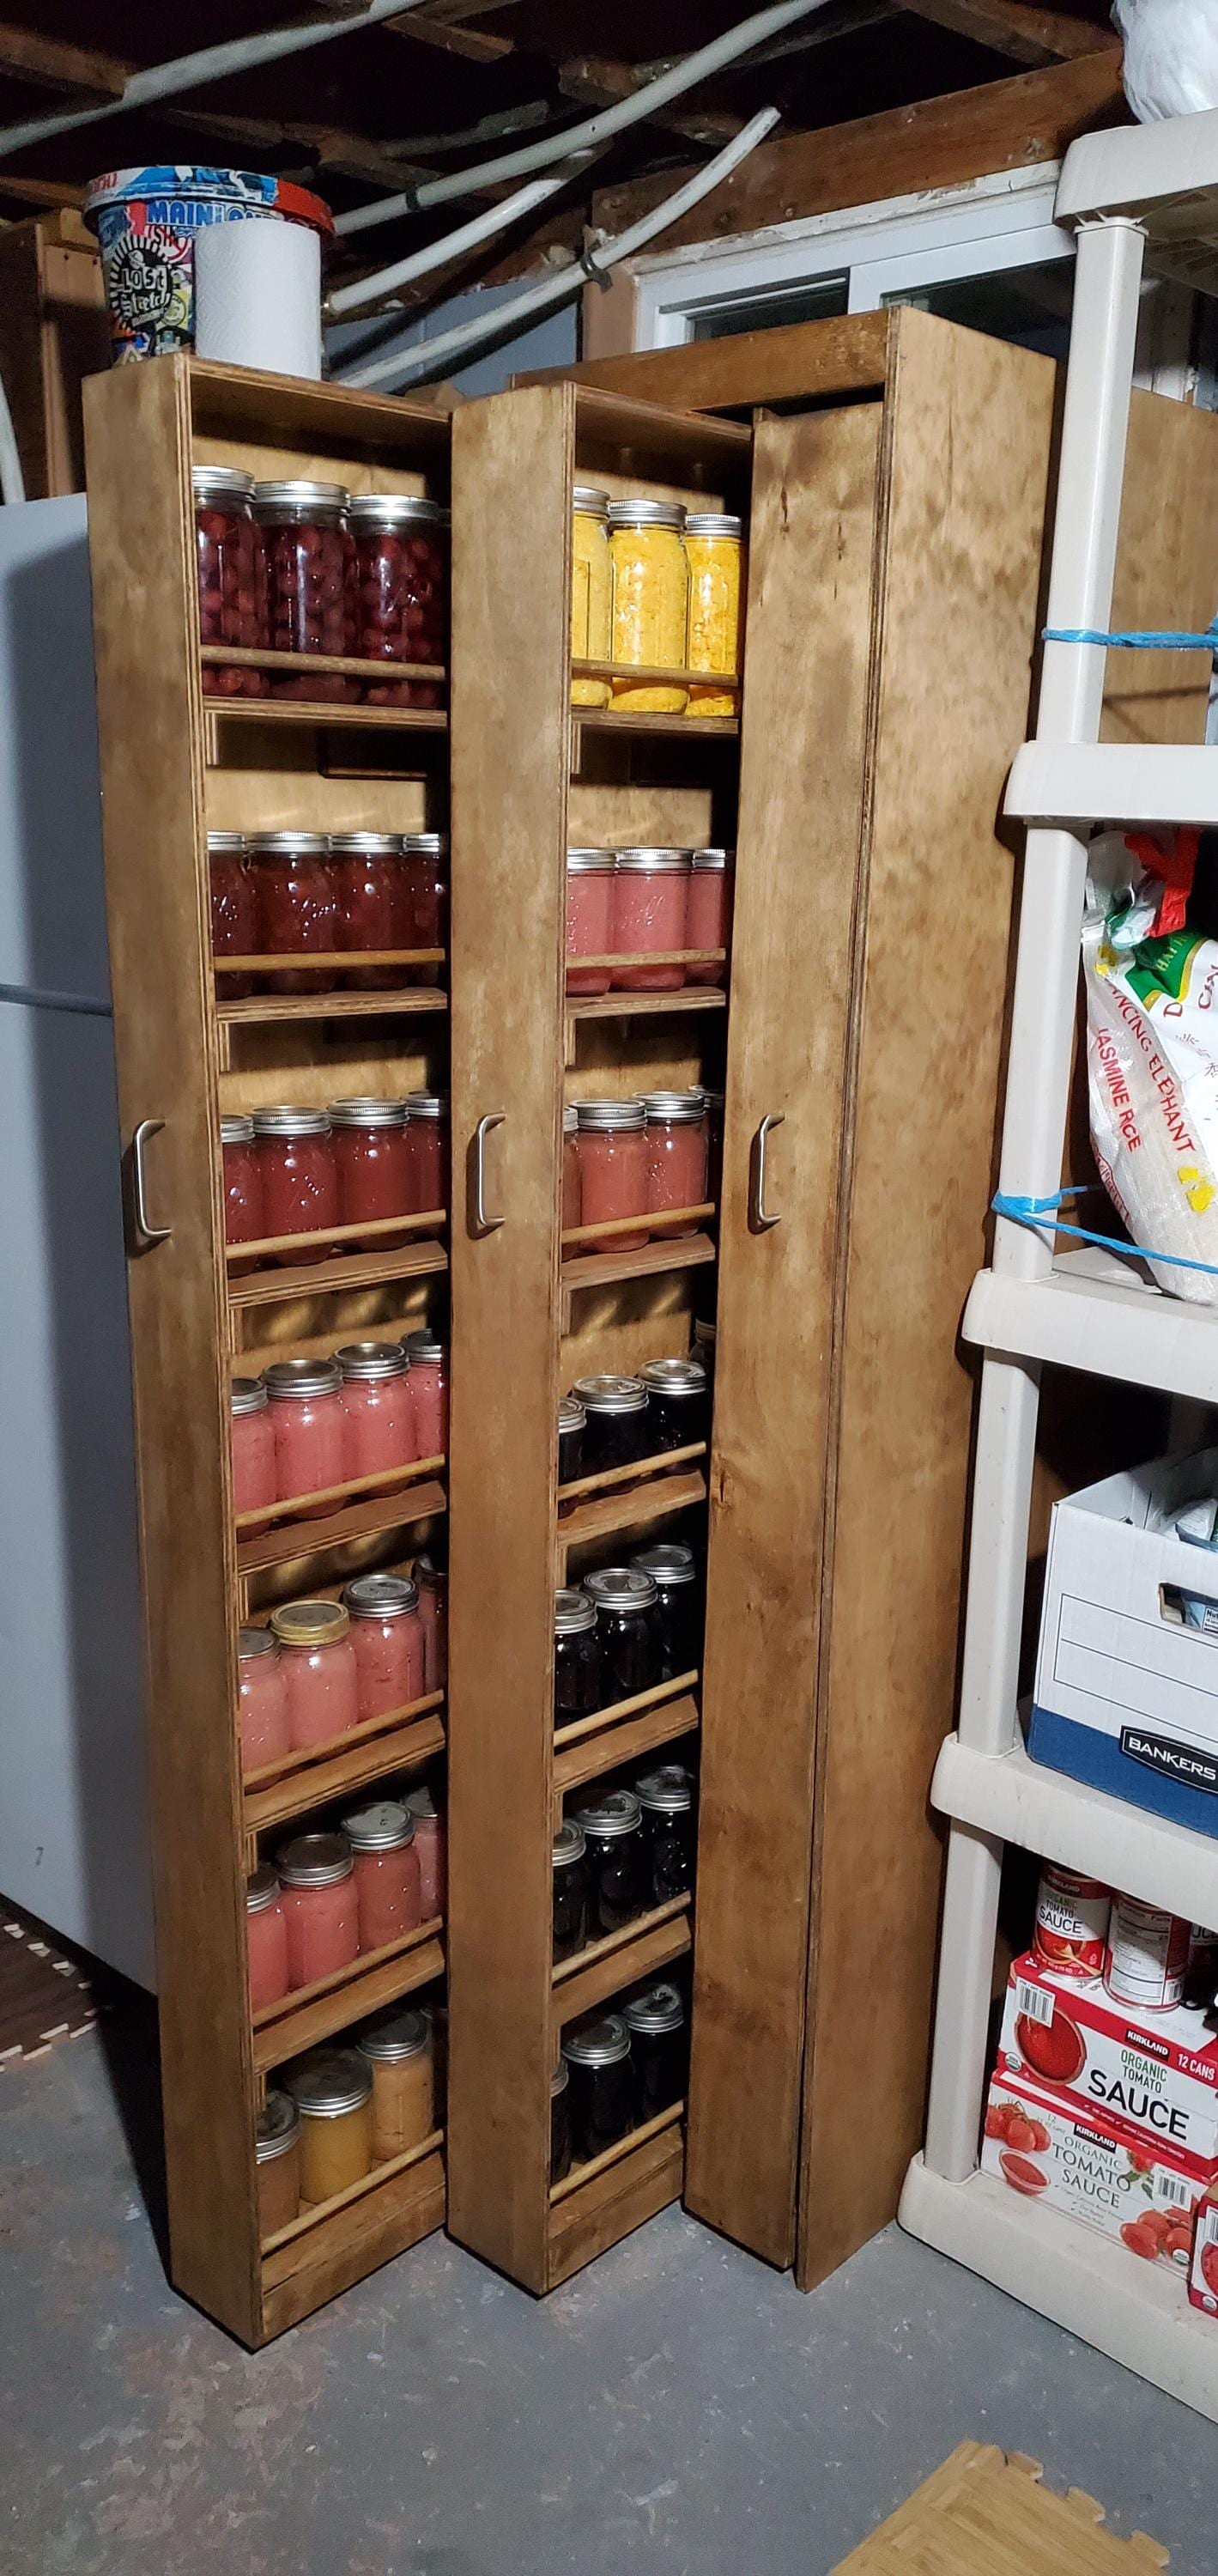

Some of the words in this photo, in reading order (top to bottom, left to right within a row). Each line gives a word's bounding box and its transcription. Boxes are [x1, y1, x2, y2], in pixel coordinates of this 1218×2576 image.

[1129, 1736, 1217, 1781] BANKERS
[1039, 1905, 1083, 1934] SAUCE
[1046, 1899, 1075, 1918] TOMATO
[1127, 2030, 1169, 2056] KIRKLAND
[1120, 2049, 1168, 2082] ORGANIC
[1123, 2065, 1162, 2093] TOMATO
[1177, 2052, 1189, 2069] 12
[1189, 2058, 1216, 2081] CANS
[1088, 2069, 1190, 2141] SAUCE
[1075, 2123, 1116, 2149] KIRKLAND
[1052, 2142, 1131, 2192] TOMATO
[1063, 2136, 1123, 2172] ORGANIC
[1062, 2168, 1120, 2209] SAUCE
